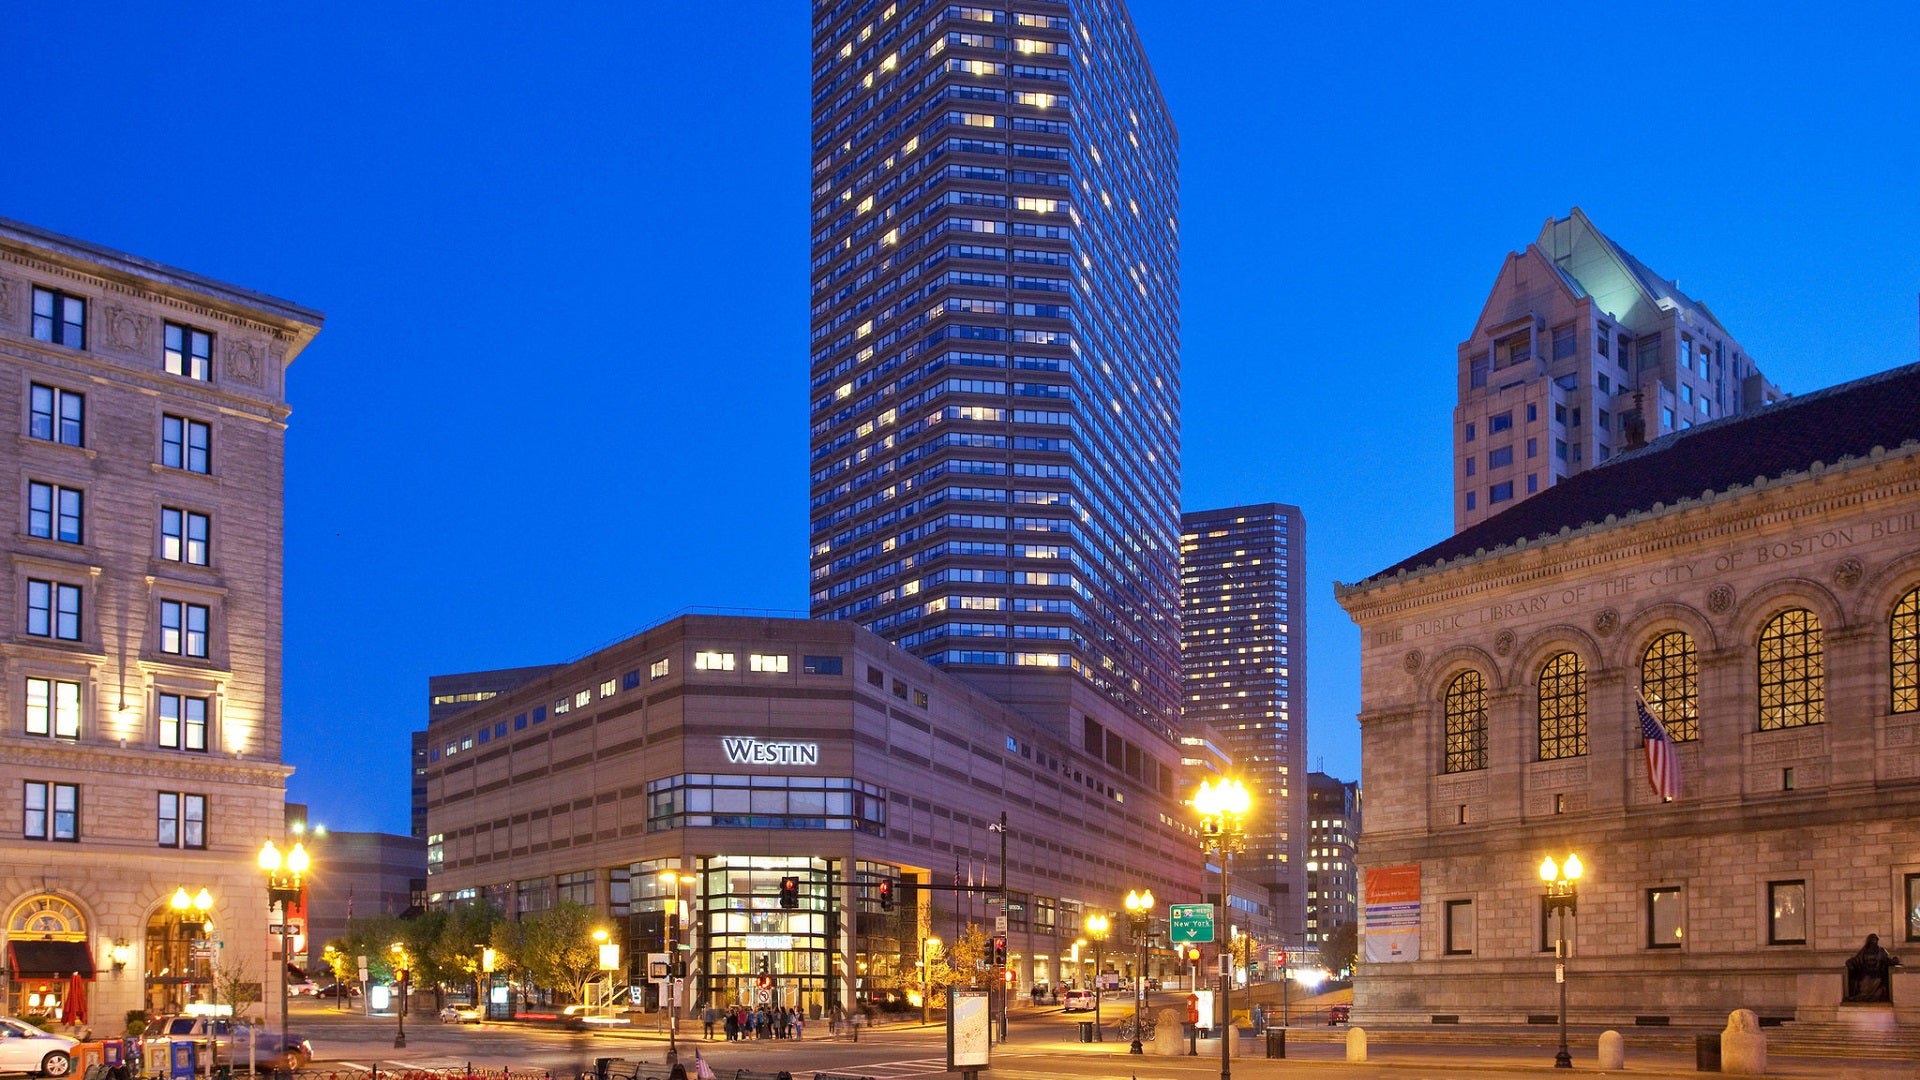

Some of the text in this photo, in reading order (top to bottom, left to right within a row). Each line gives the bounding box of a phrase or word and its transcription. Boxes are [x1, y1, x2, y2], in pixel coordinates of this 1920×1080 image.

[1377, 627, 1401, 645] THE
[1414, 614, 1465, 637] PUBLIC
[1479, 594, 1550, 624] LIBRARY
[1561, 585, 1587, 606] OF
[1601, 575, 1636, 597] THE
[1649, 561, 1699, 586] CITY
[1714, 552, 1743, 572] OF
[1757, 529, 1854, 563] BOSTON
[724, 738, 817, 763] WESTIN
